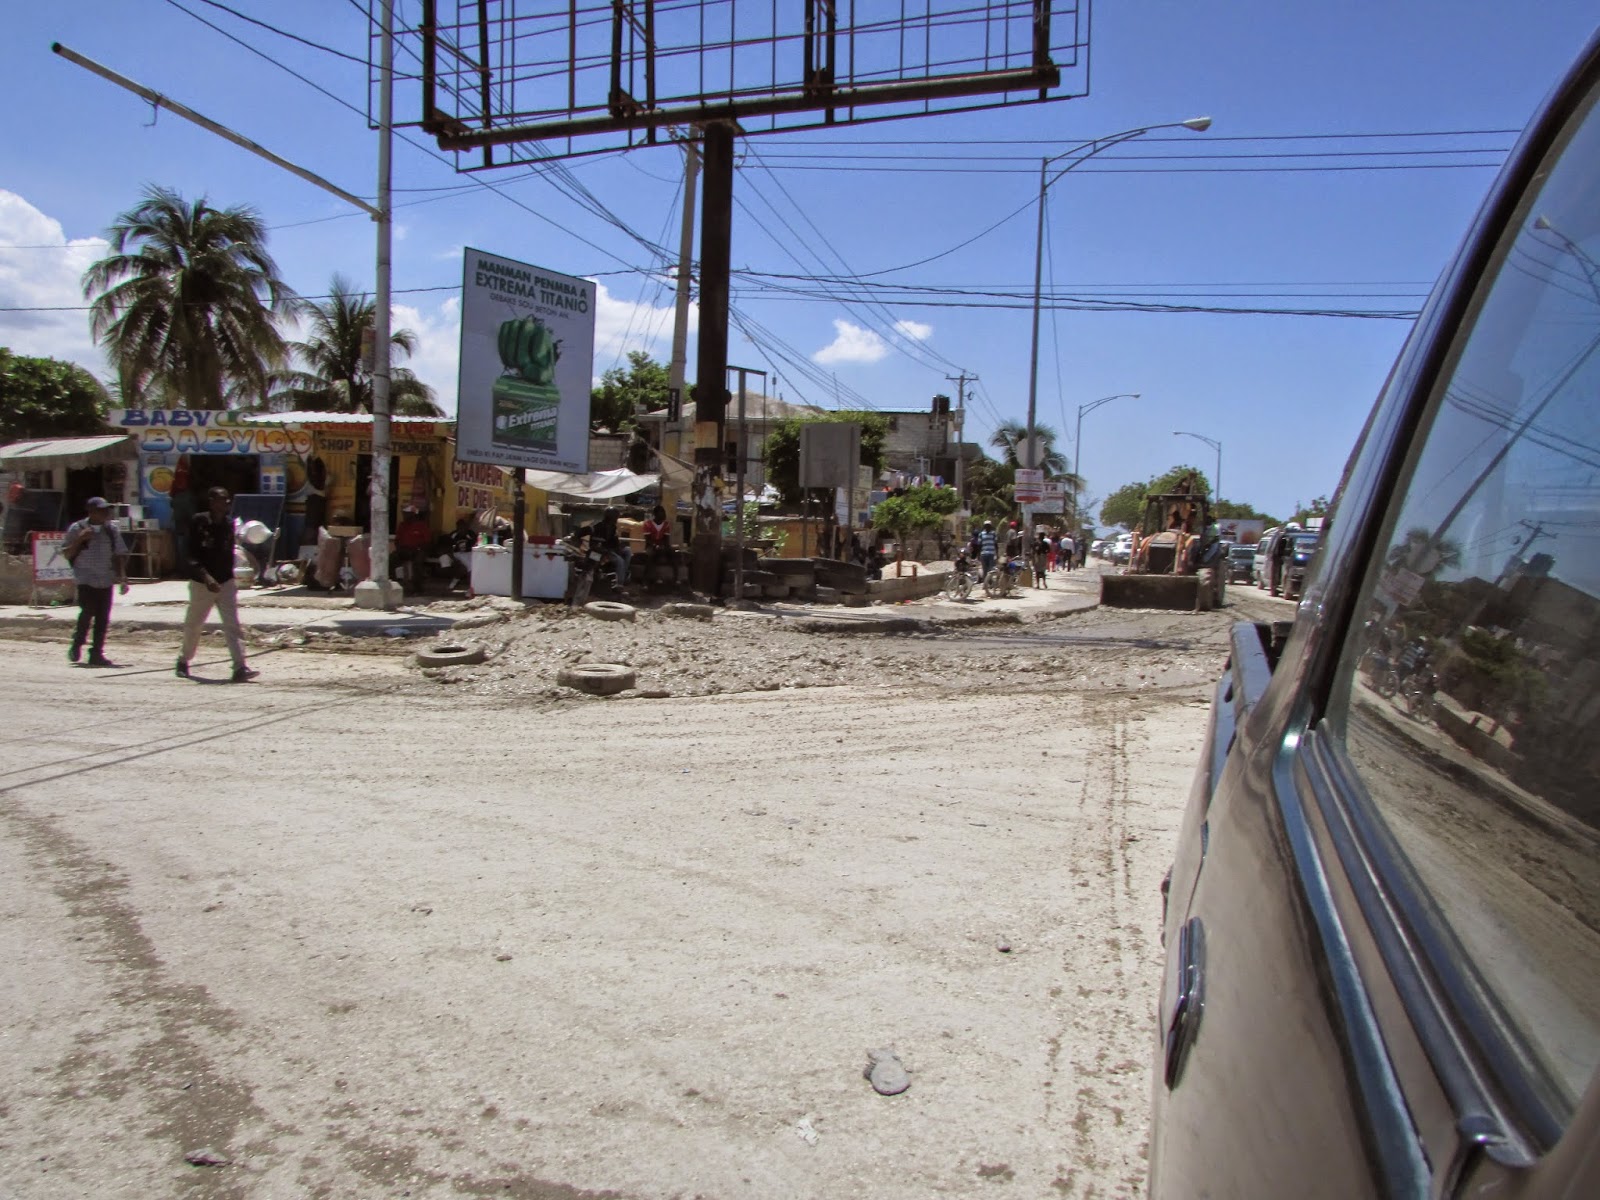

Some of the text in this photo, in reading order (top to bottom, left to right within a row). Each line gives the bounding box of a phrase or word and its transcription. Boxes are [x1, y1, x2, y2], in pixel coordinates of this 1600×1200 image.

[477, 259, 531, 283] MANMAN
[580, 288, 587, 299] A
[476, 272, 588, 314] EXTREMA TITANIO
[121, 410, 211, 426] BABY
[508, 407, 557, 428] Extrema
[142, 429, 254, 453] BABY
[319, 438, 353, 452] SHOP
